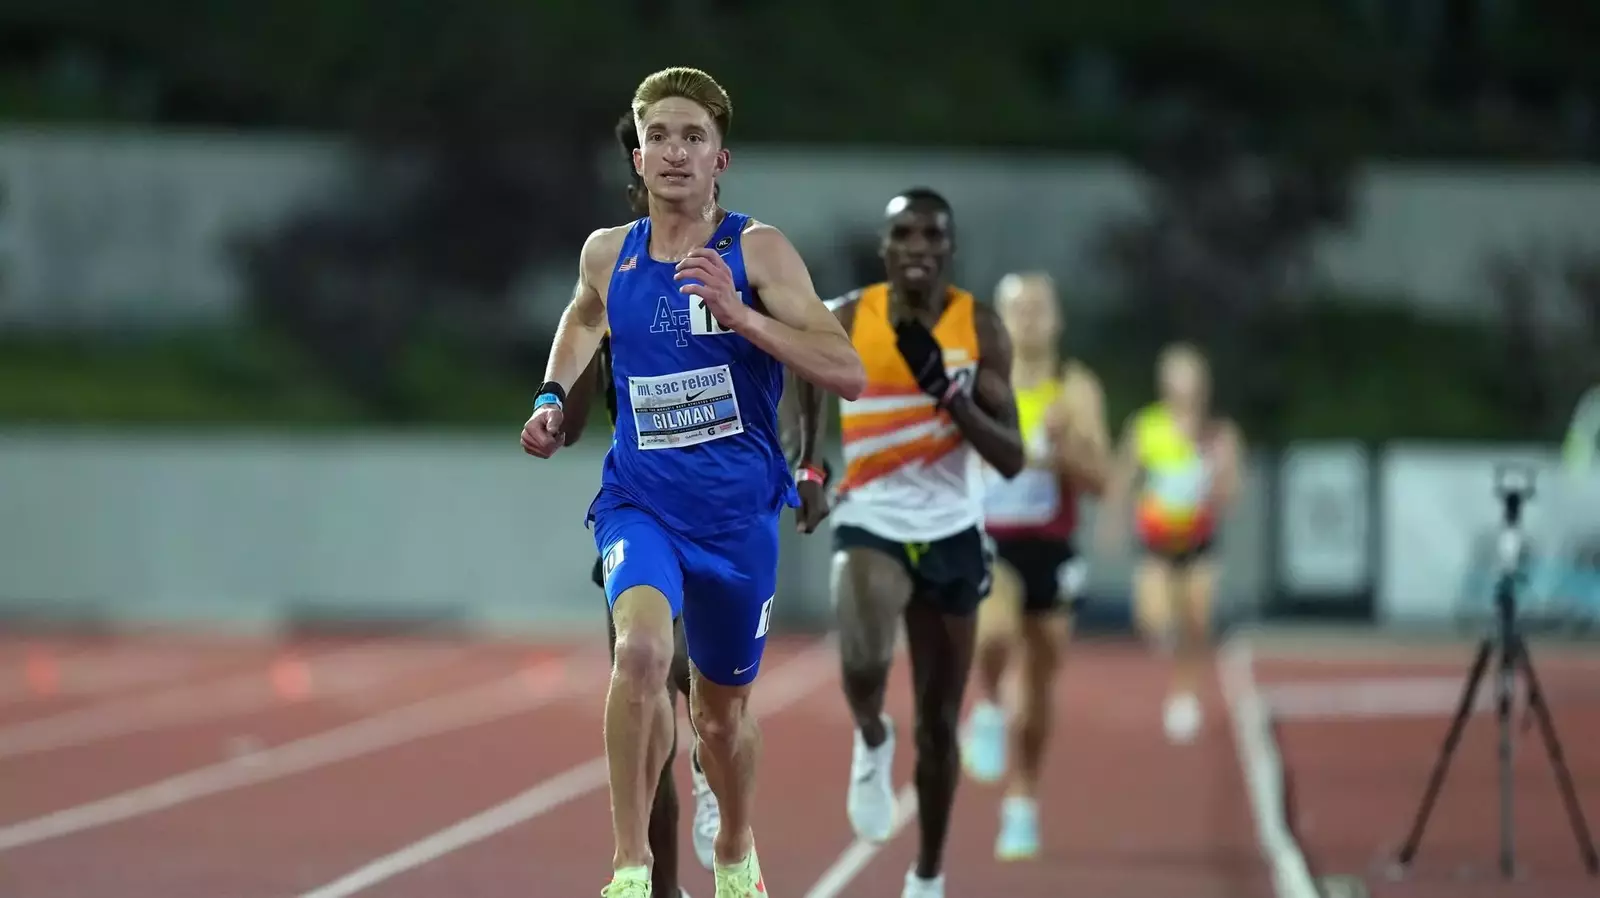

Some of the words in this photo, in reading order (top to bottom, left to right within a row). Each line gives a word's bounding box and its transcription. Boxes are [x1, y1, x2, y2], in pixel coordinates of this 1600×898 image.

[698, 299, 733, 333] 1
[655, 381, 679, 396] sac
[682, 372, 725, 391] relays
[652, 404, 716, 429] GILMAN
[707, 427, 716, 436] G
